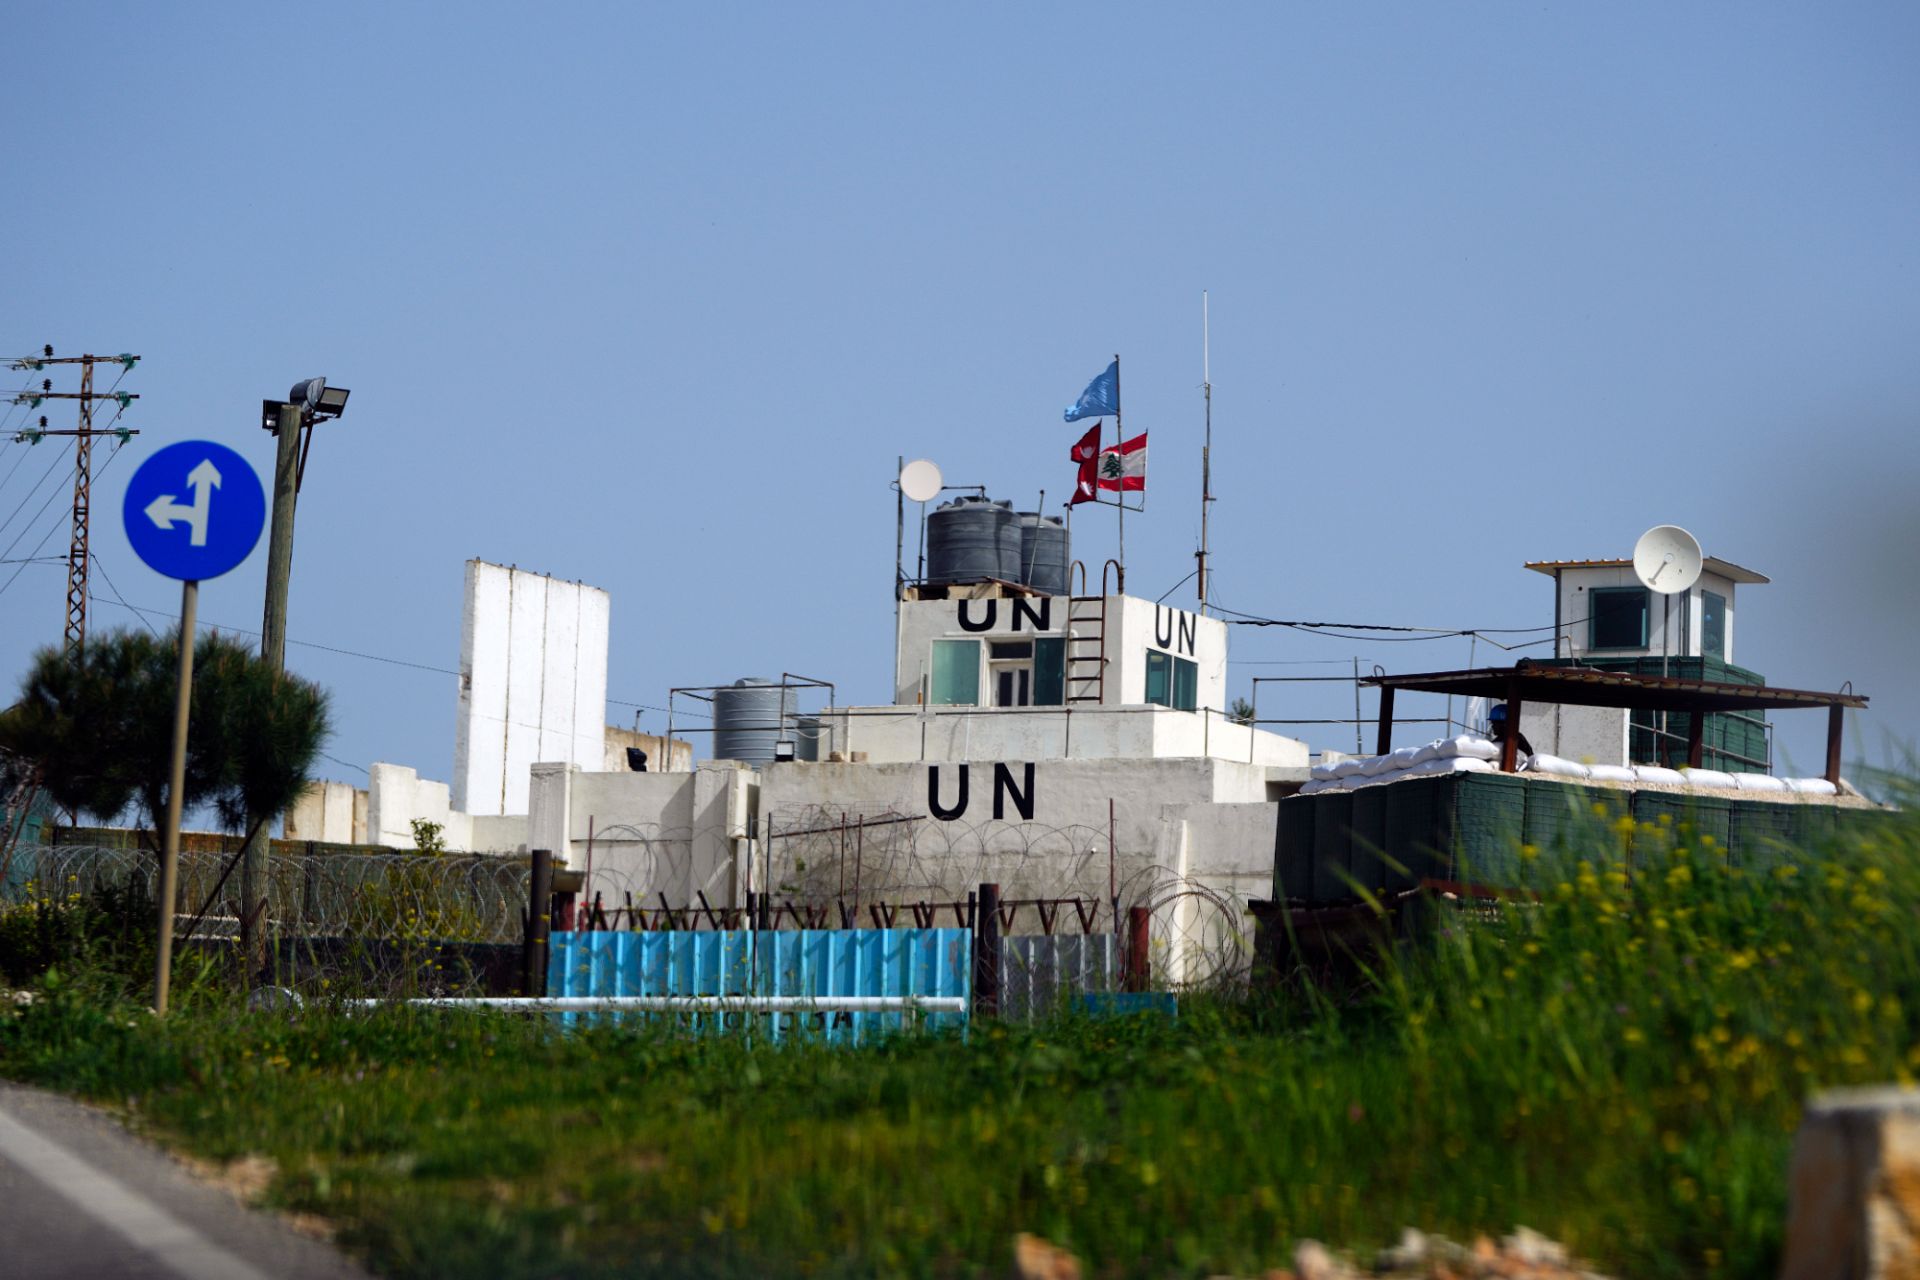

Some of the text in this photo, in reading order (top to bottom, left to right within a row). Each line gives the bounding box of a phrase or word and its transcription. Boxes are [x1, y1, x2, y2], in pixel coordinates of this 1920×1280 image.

[957, 598, 1050, 632] UN
[1155, 604, 1196, 656] UN
[928, 762, 1035, 821] UN
